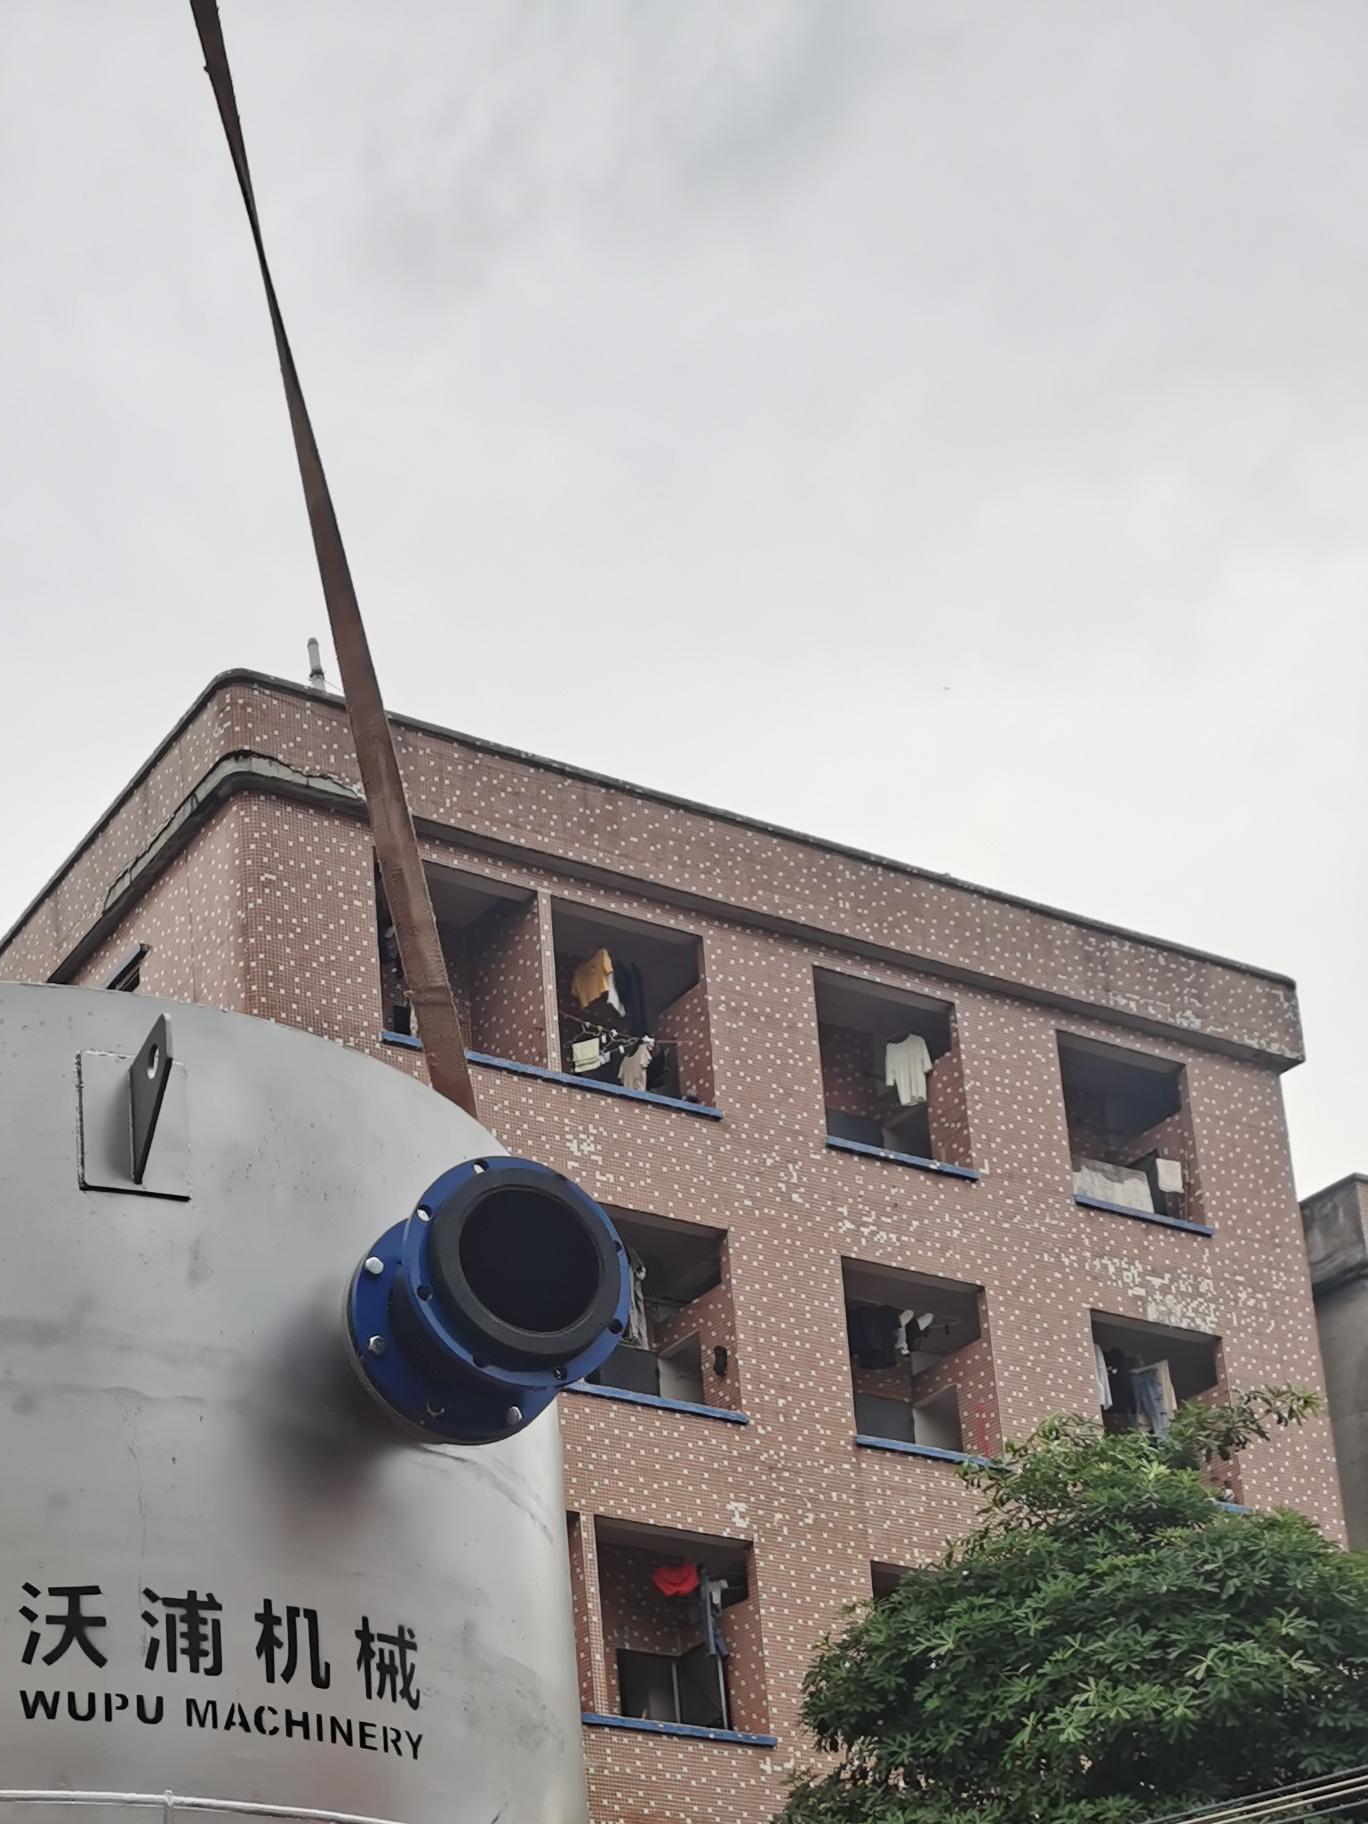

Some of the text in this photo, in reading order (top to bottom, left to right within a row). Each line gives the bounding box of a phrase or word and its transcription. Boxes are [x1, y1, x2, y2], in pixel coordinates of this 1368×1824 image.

[18, 1581, 421, 1711] 沃浦机械
[19, 1689, 424, 1761] WUPU MACHINERY
